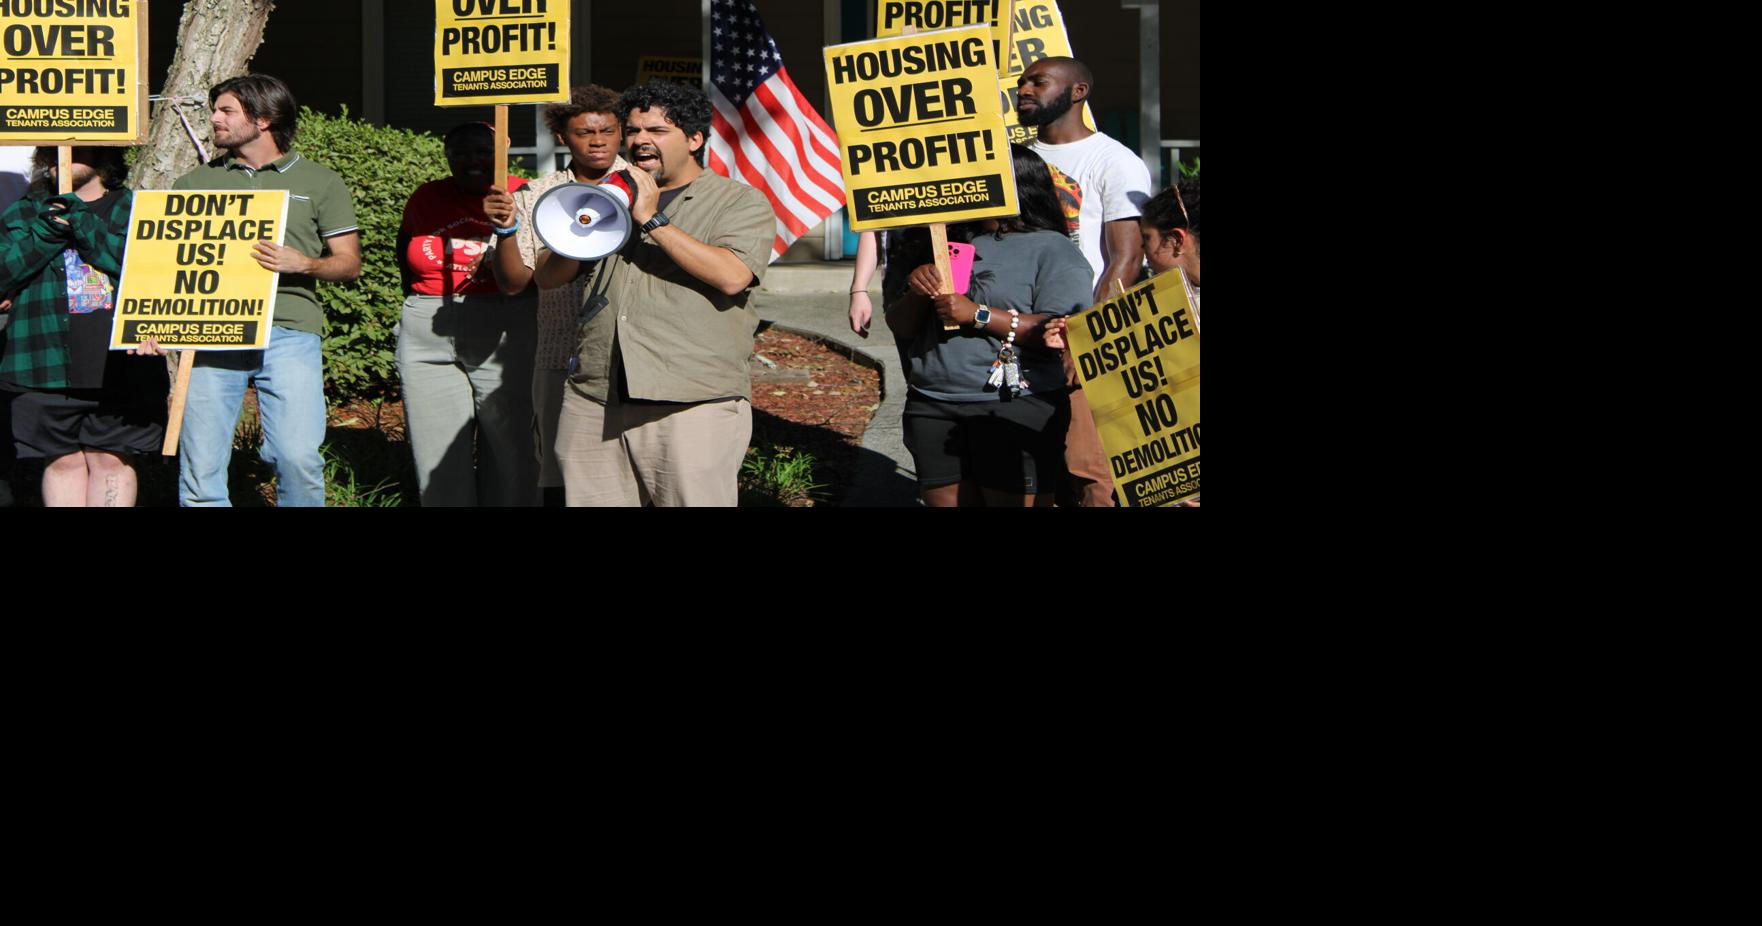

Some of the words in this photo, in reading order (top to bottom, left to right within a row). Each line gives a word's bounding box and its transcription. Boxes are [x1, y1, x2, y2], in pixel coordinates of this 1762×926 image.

[885, 0, 998, 28] PROFIT!
[4, 24, 114, 56] OVER
[442, 22, 556, 55] PROFIT!
[643, 60, 703, 73] HOUSIN
[832, 37, 986, 84] HOUSING
[0, 68, 125, 94] PROFIT!
[453, 70, 506, 82] CAMPUS
[509, 68, 546, 80] EDGE
[453, 83, 489, 91] TENANTS
[490, 80, 547, 89] ASSOCIATION
[853, 77, 977, 127] OVER
[6, 109, 69, 119] CAMPUS
[73, 109, 114, 119] EDGE
[848, 129, 995, 175] PROFIT!
[868, 186, 937, 203] CAMPUS
[941, 180, 988, 196] EDGE
[868, 202, 917, 213] TENANTS
[918, 193, 989, 207] ASSOCIATION
[164, 194, 254, 216] DON'T
[136, 220, 274, 240] DISPLACE
[176, 243, 226, 266] US!
[174, 270, 219, 294] NO
[122, 299, 264, 316] DEMOLITION!
[1086, 283, 1159, 342] DON'T
[135, 334, 178, 342] TENANTS
[179, 335, 243, 343] ASSOCIATION
[136, 323, 200, 334] CAMPUS
[203, 324, 244, 335] EDGE
[1078, 308, 1193, 382] DISPLACE
[1121, 355, 1168, 398] US!
[1135, 393, 1178, 436] NO
[1135, 468, 1187, 497] CAMPUS
[1138, 488, 1175, 507] TENANTS
